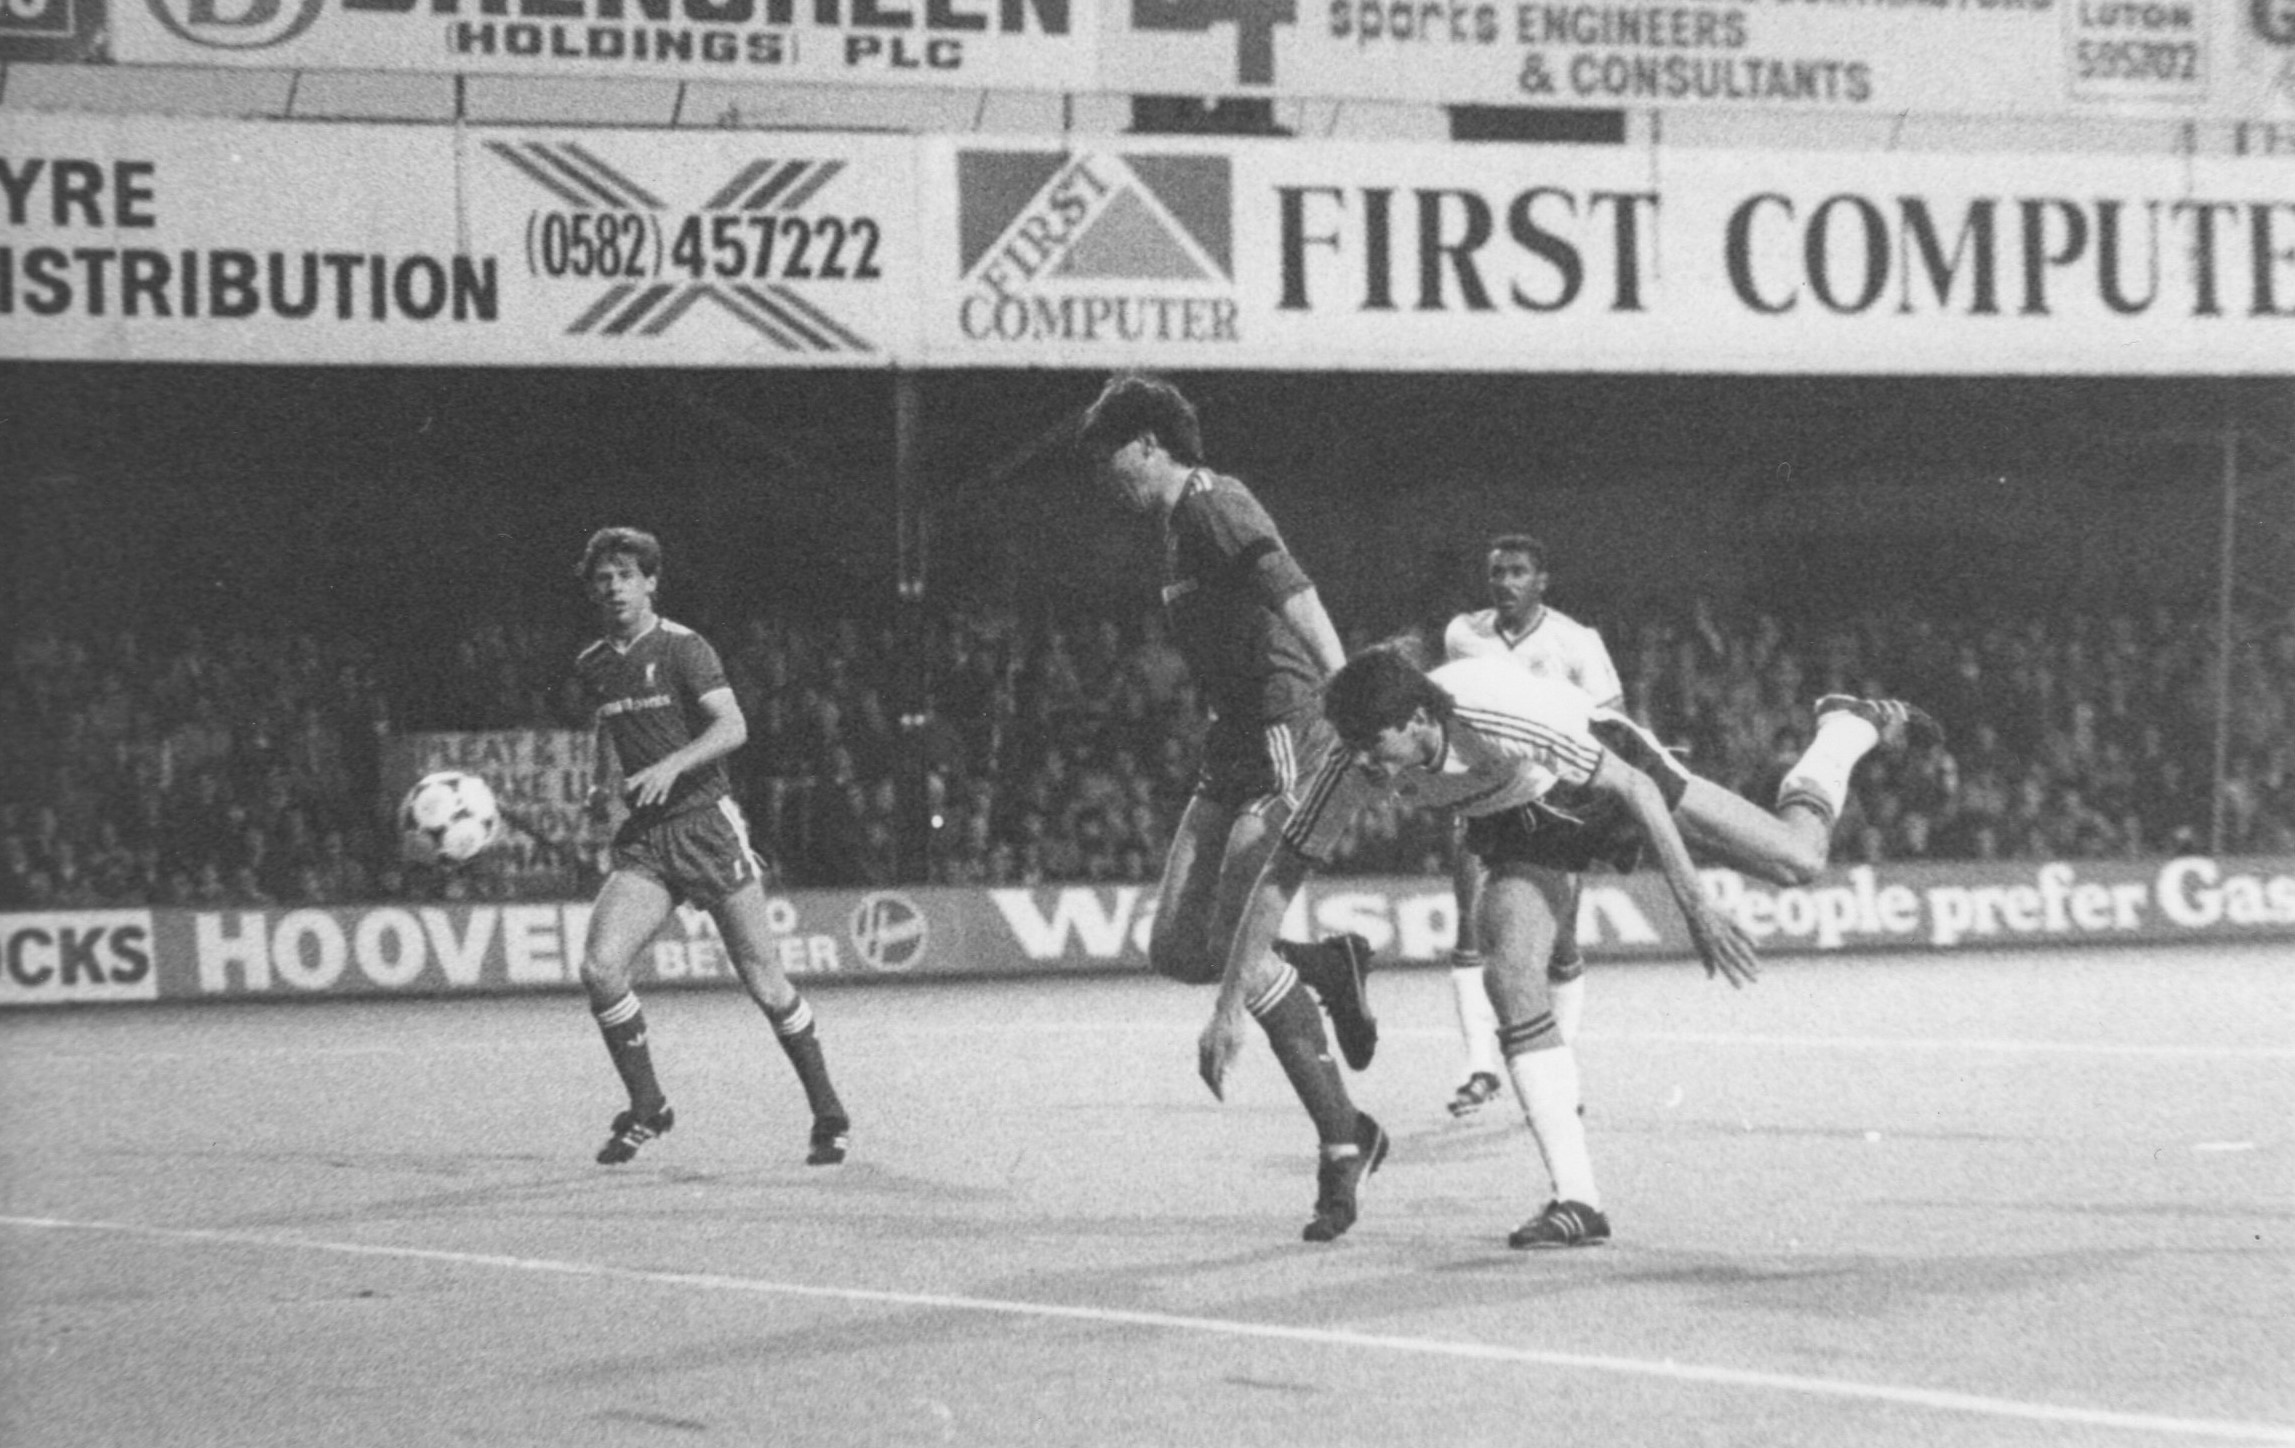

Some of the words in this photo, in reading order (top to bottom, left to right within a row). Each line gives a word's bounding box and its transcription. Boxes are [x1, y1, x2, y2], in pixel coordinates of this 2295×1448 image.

[1517, 5, 1748, 49] ENGINEERS
[2077, 0, 2193, 28] LUTON
[845, 36, 963, 70] PLC
[1518, 54, 1554, 95] &
[1568, 54, 1871, 102] CONSULTANTS
[0, 158, 156, 228] YRE
[980, 163, 1109, 301] FIRST
[1272, 185, 1661, 312] FIRST
[0, 247, 498, 320] ISTRIBUTION
[959, 296, 1238, 342] COMPUTER
[1927, 861, 2148, 946] prefer
[6, 925, 150, 987] CKS
